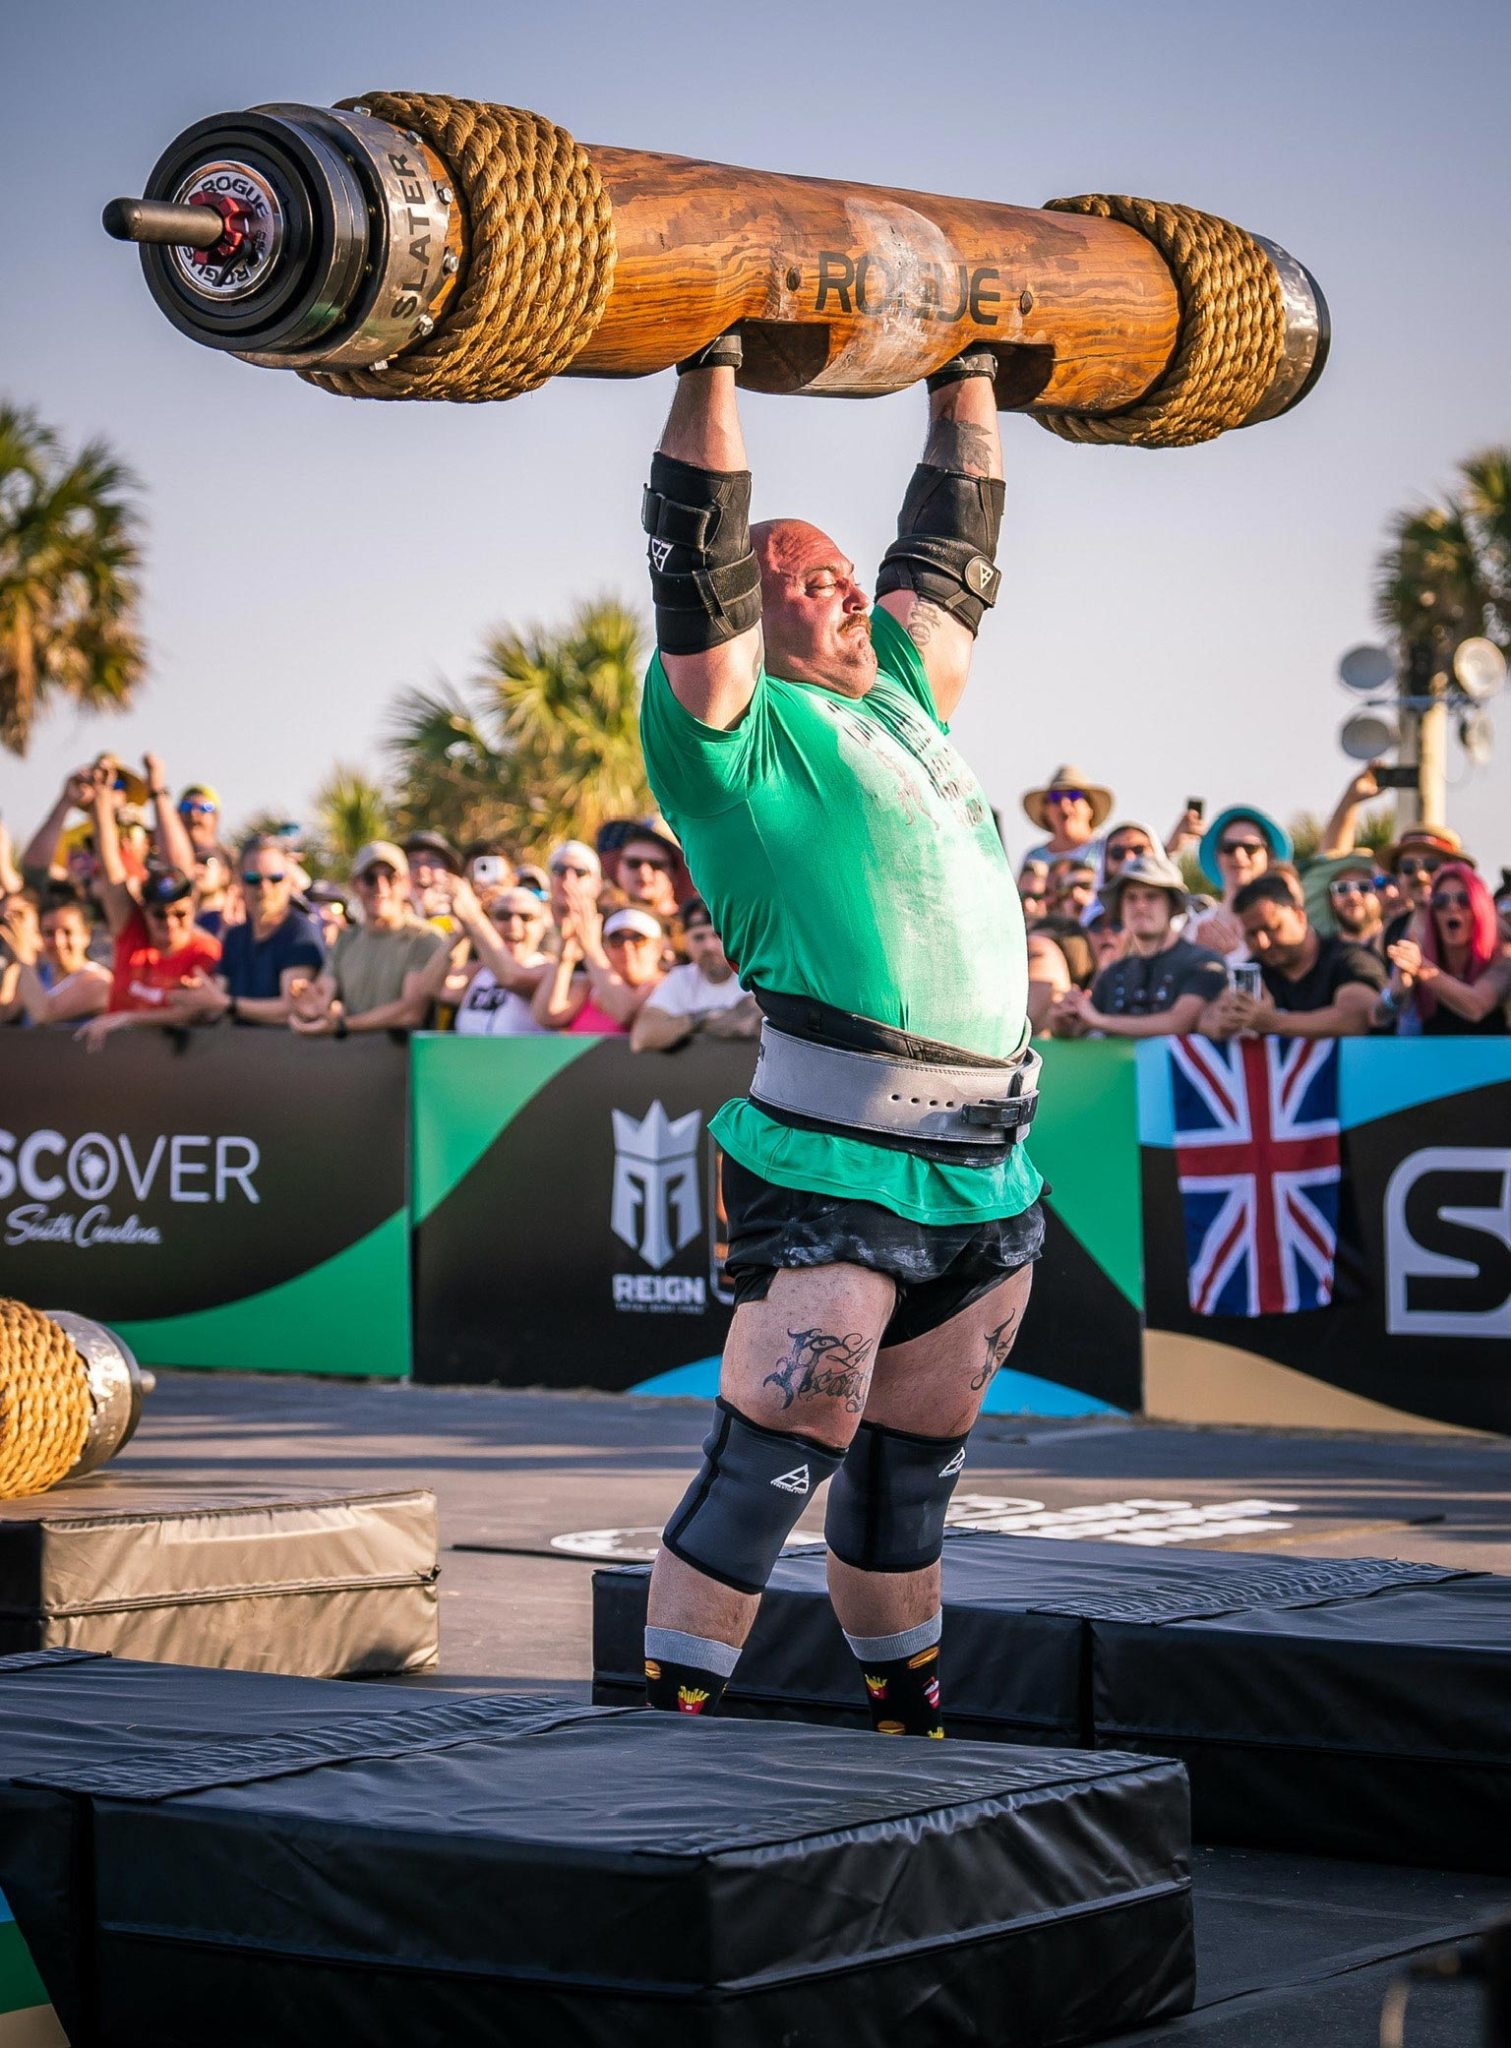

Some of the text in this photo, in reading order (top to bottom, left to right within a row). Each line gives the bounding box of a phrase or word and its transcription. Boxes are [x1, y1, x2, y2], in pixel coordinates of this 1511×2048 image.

[201, 176, 269, 218] ROGUE
[388, 153, 431, 319] SLATER
[612, 1274, 706, 1304] REIGN
